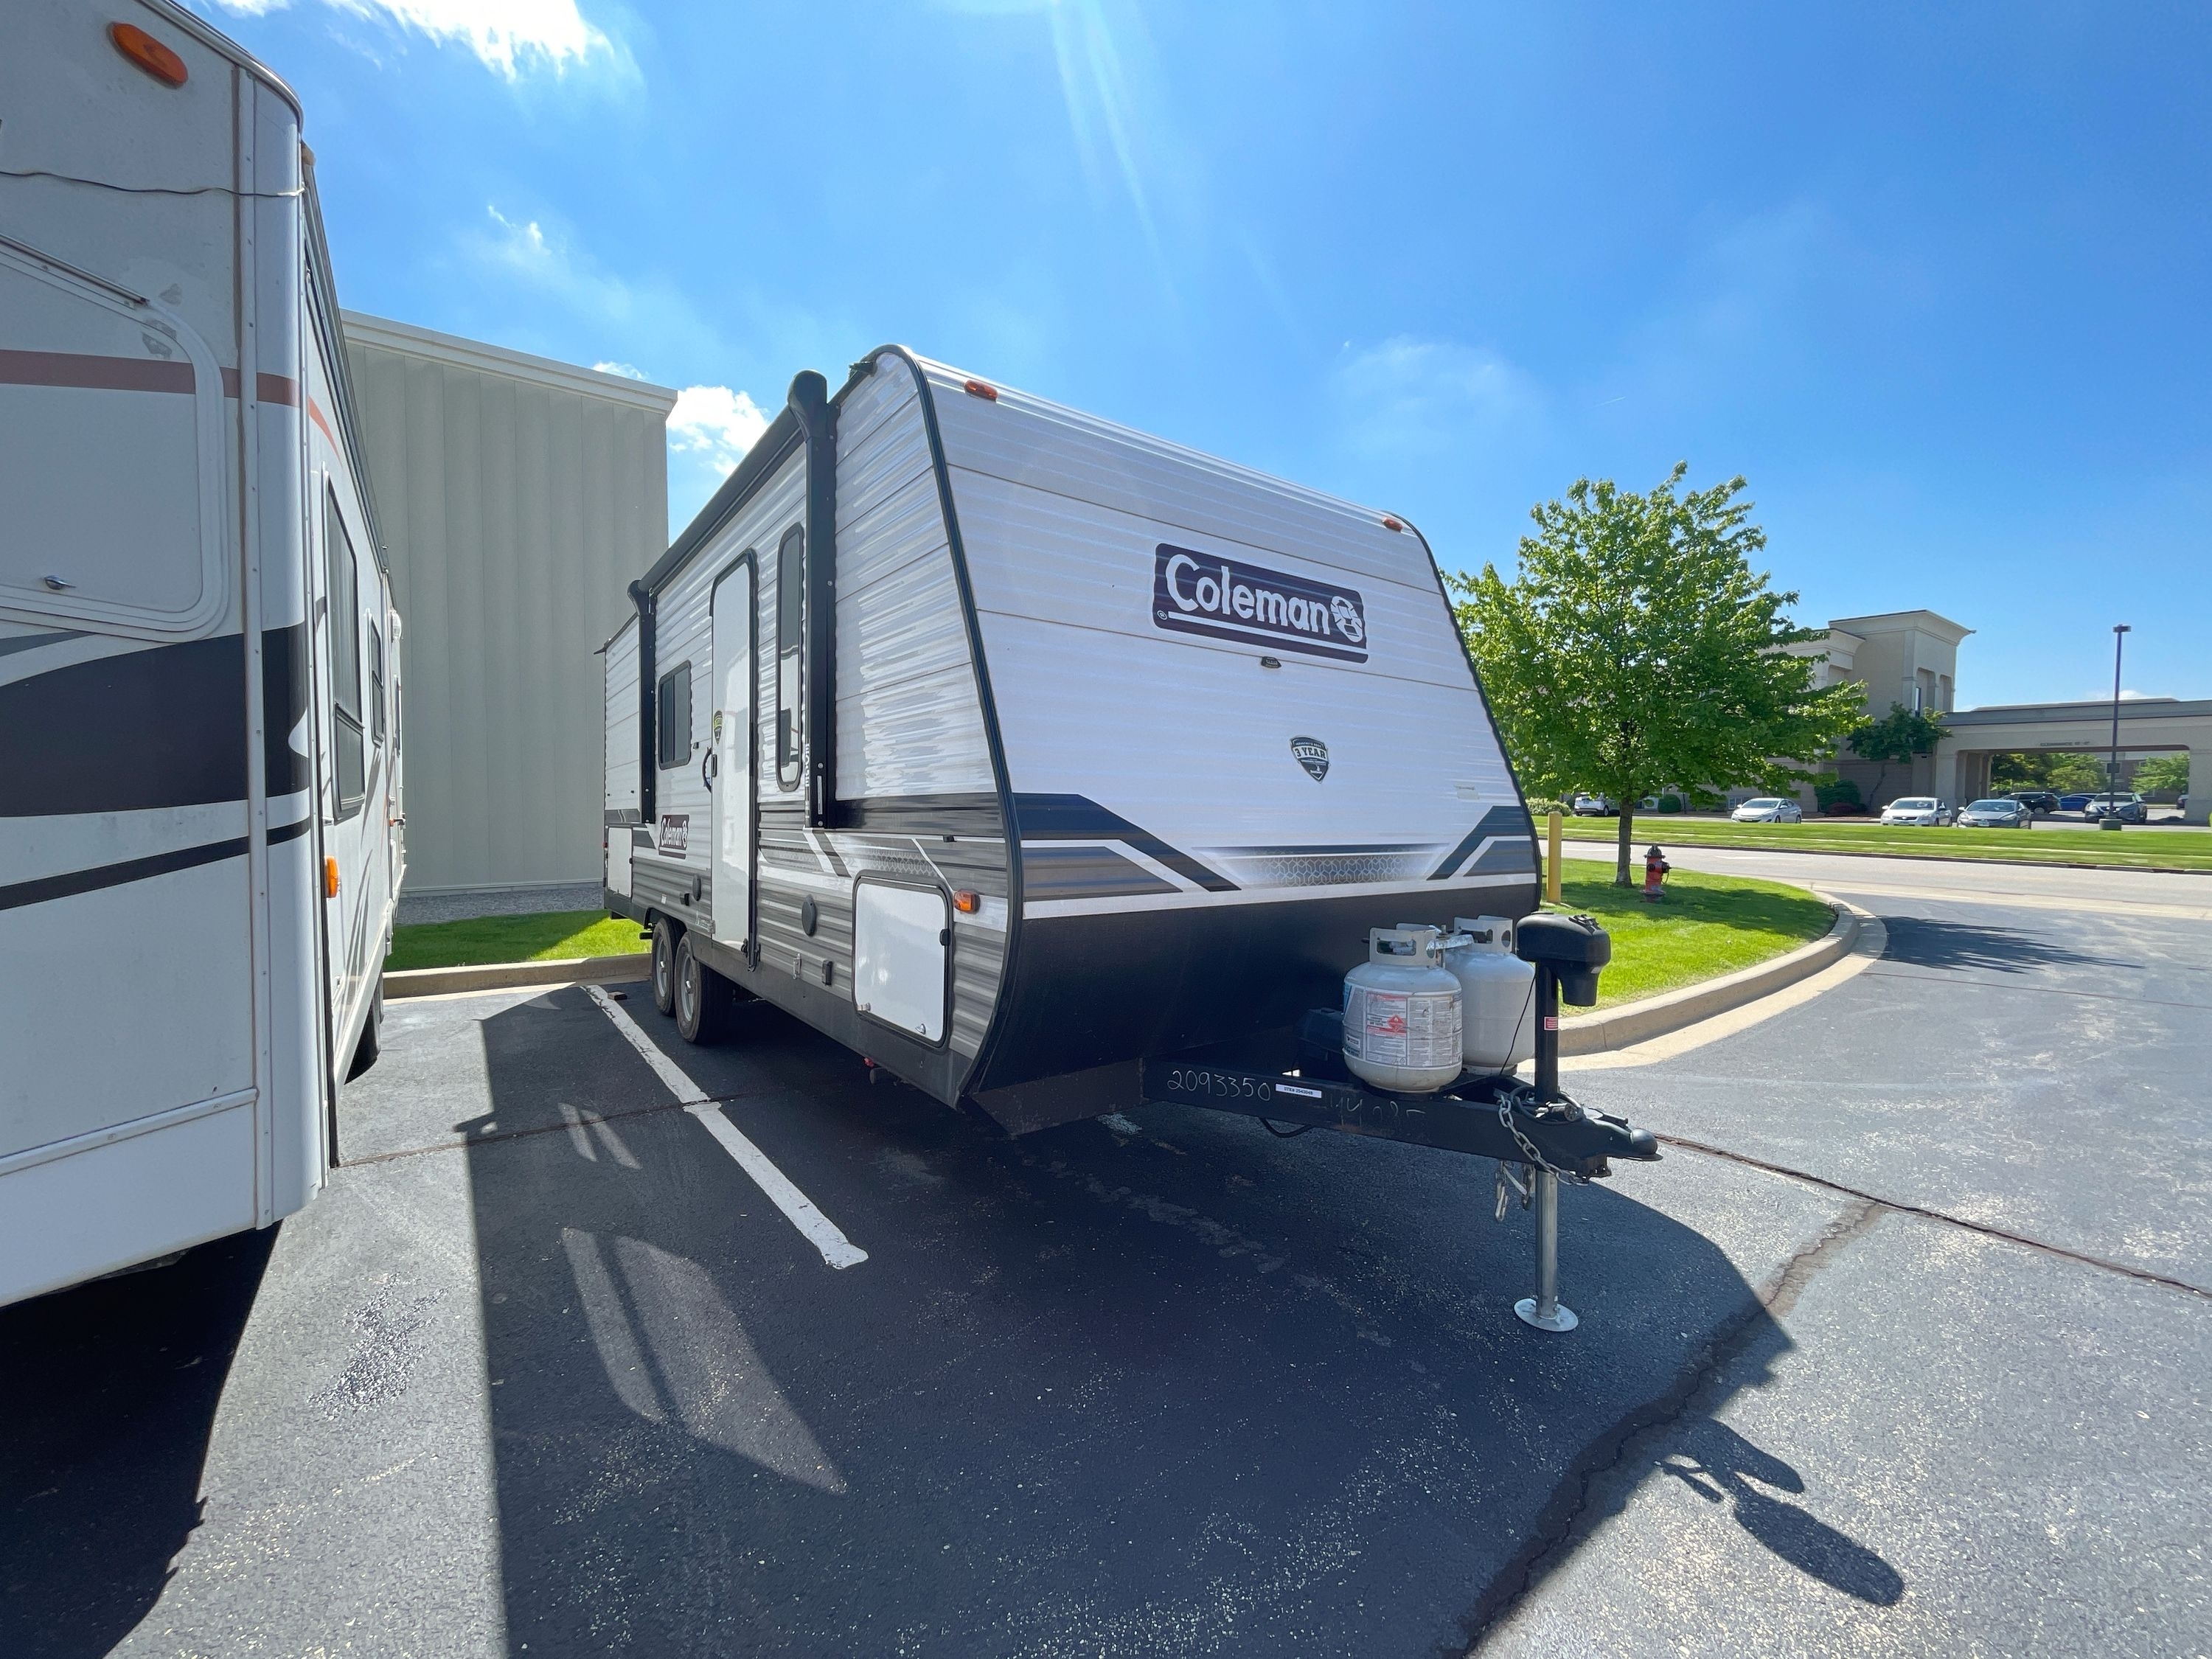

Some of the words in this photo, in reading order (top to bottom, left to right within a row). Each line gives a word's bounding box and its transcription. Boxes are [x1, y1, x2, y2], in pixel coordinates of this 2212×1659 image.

[1165, 554, 1330, 635] Coleman
[1294, 748, 1301, 757] 3
[1301, 747, 1326, 759] YEAR
[661, 818, 683, 846] Coleman
[1167, 1070, 1271, 1102] 2093350
